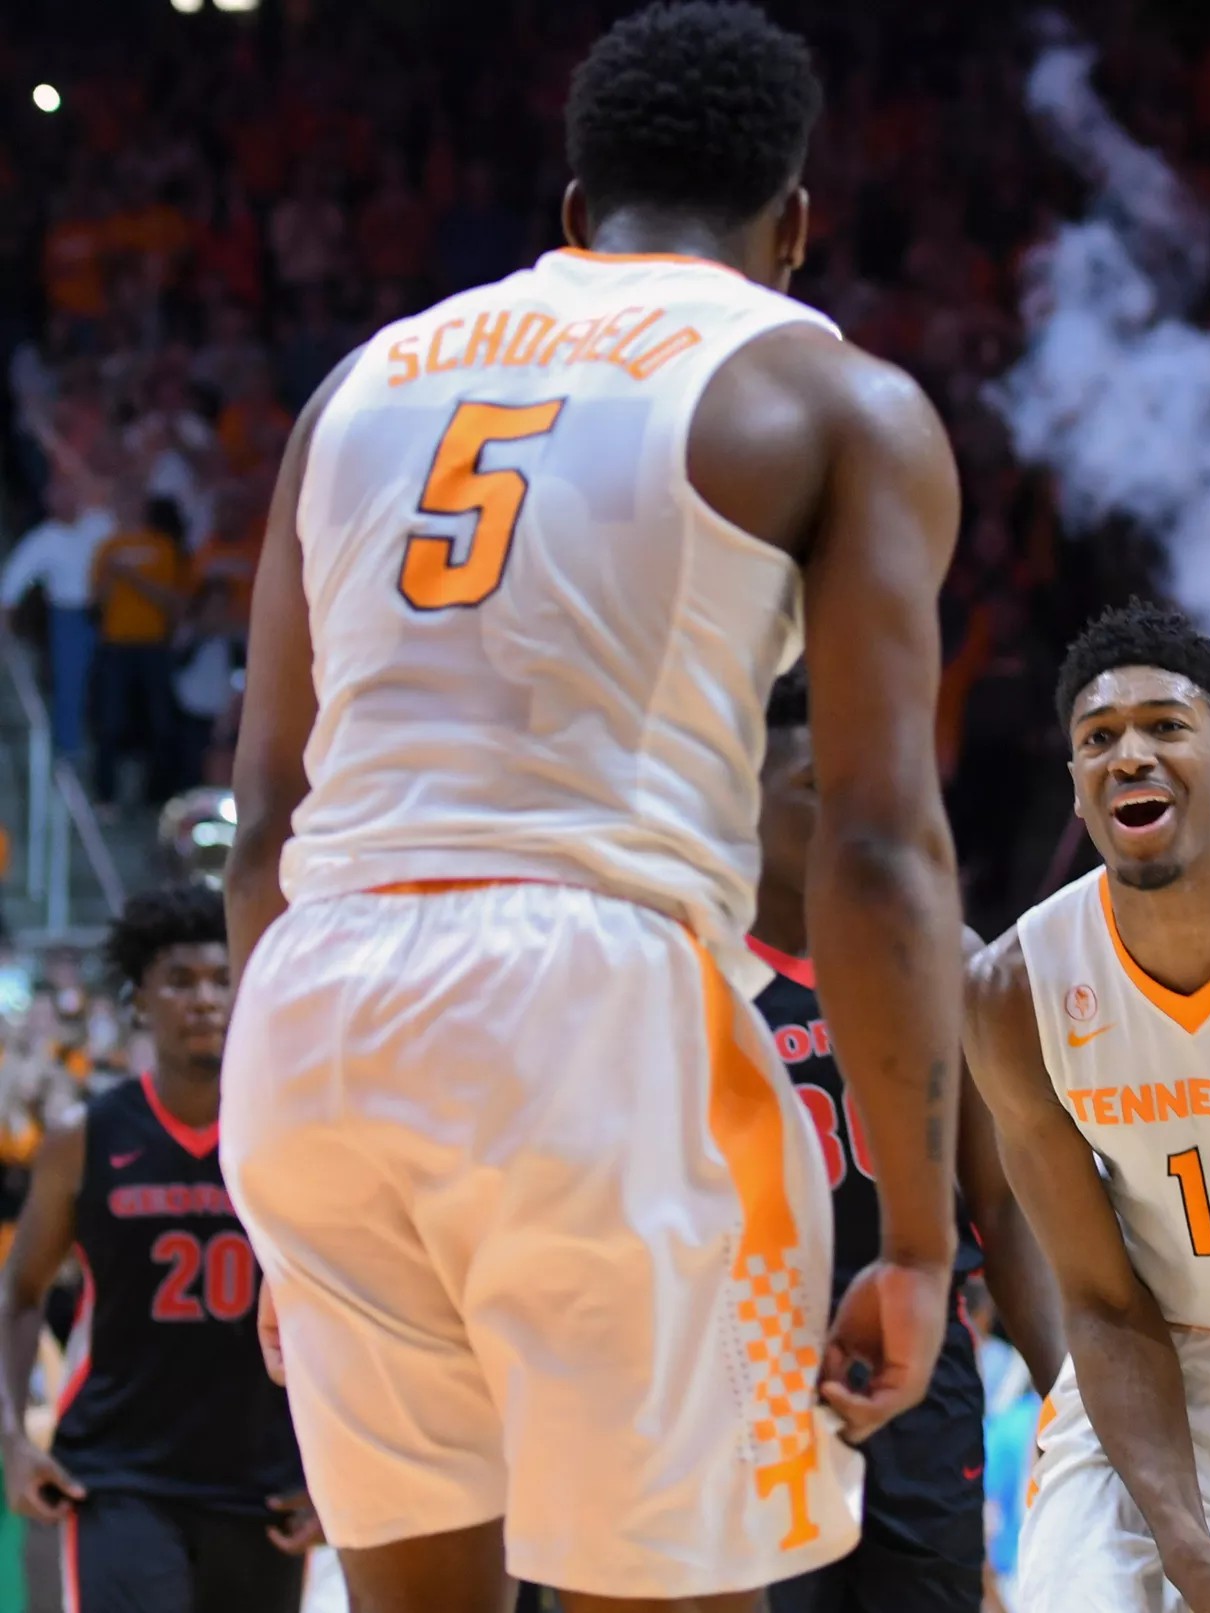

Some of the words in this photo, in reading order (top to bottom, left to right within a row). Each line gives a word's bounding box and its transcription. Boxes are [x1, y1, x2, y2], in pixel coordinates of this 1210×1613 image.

[397, 397, 567, 611] 5
[152, 1231, 254, 1321] 20
[755, 1443, 820, 1551] T
